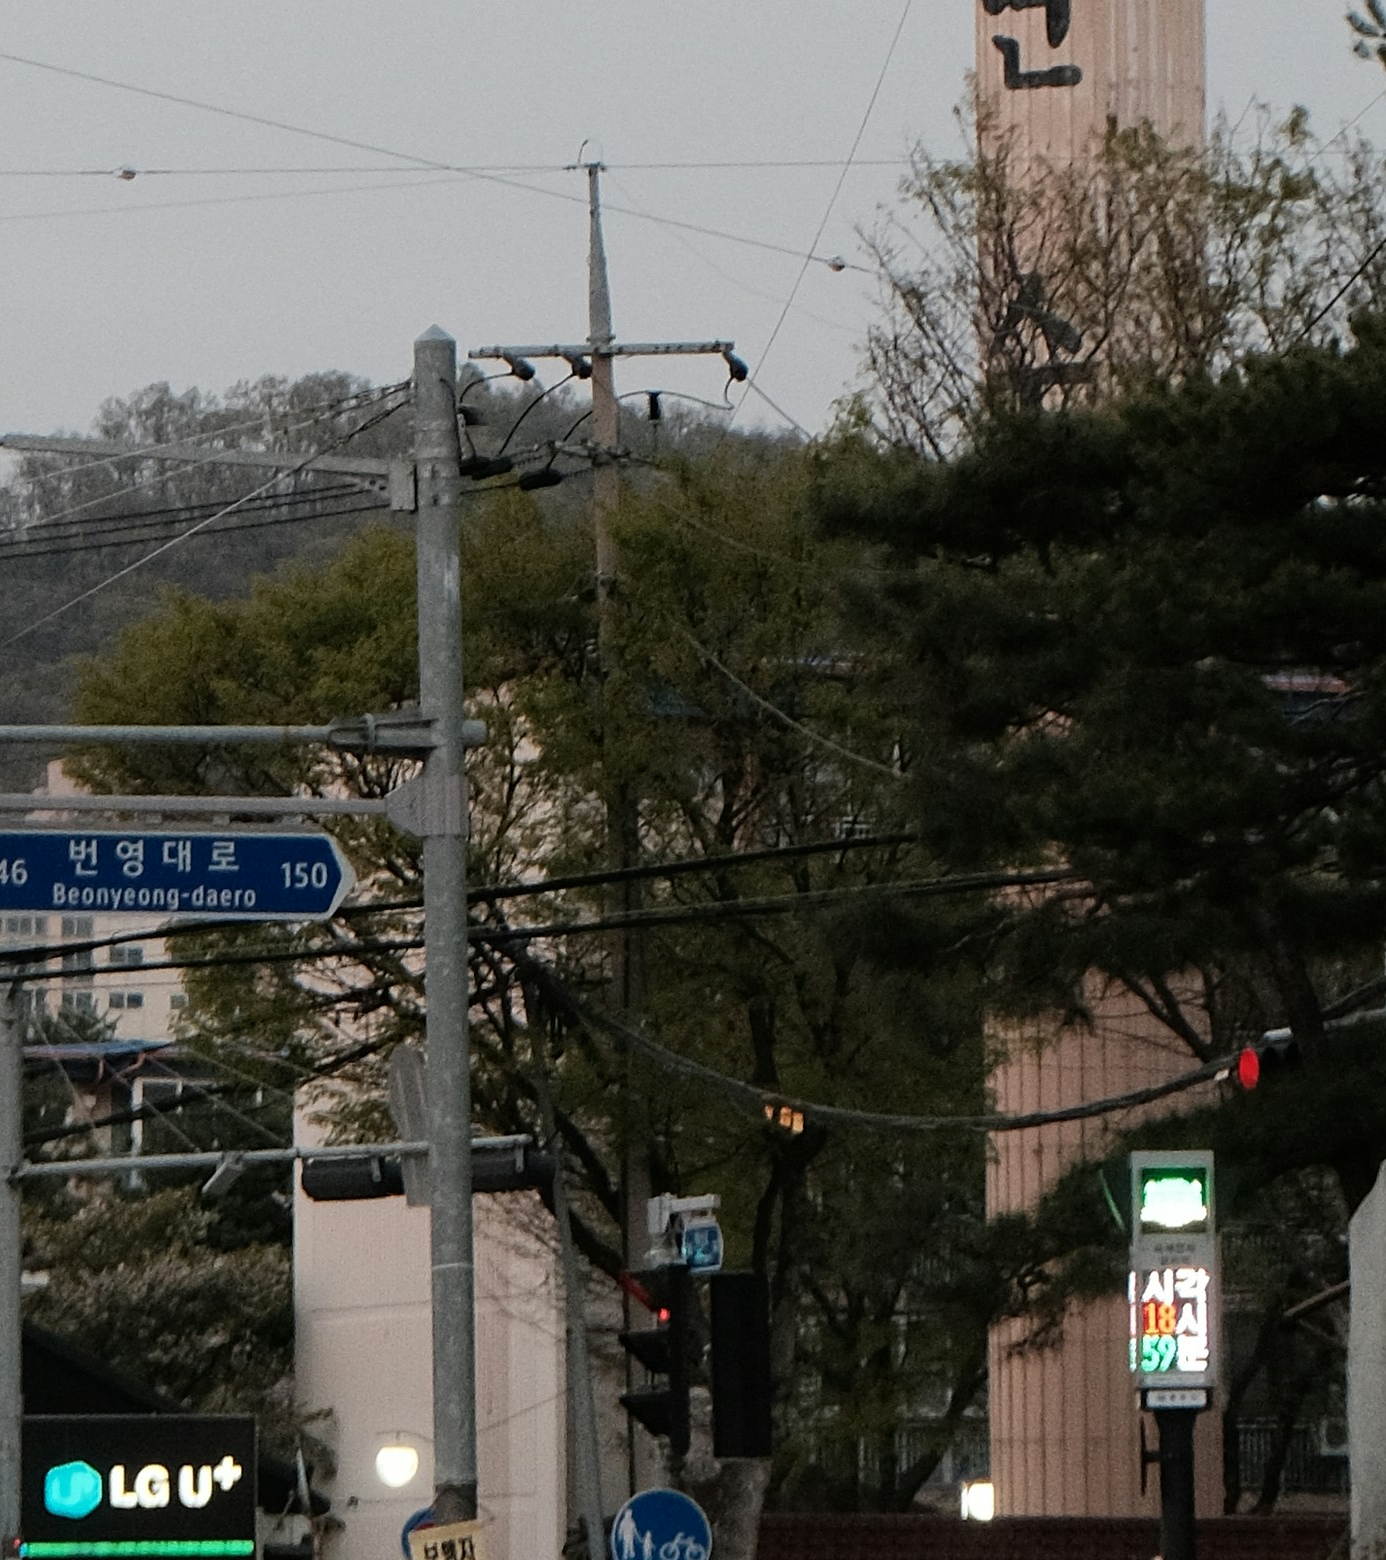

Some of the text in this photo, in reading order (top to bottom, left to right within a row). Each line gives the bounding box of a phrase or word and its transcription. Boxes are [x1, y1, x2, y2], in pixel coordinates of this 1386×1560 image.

[68, 838, 240, 877] 번영대로
[280, 861, 329, 889] 150
[52, 883, 257, 912] Beonyeong-daero
[1142, 1267, 1211, 1302] 시각
[108, 1463, 171, 1510] LG
[177, 1455, 243, 1510] U+
